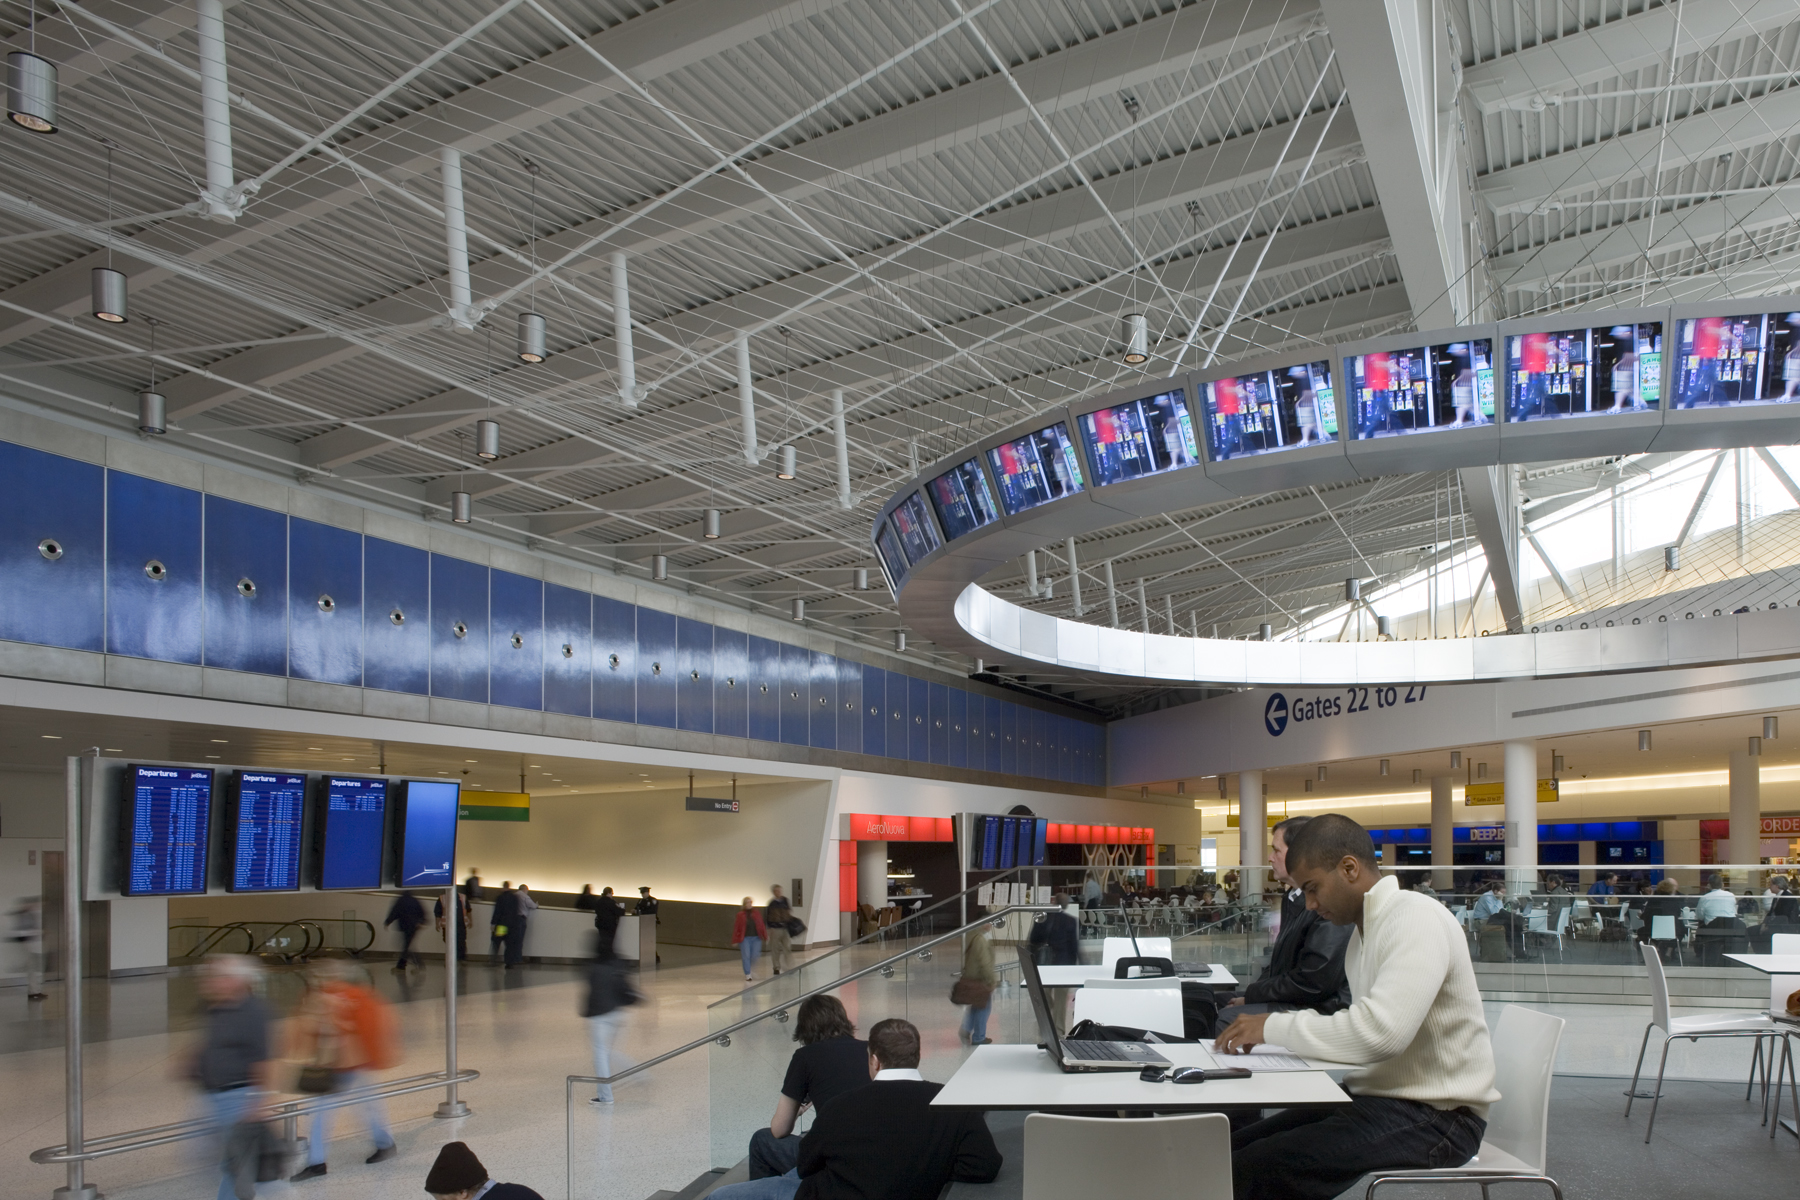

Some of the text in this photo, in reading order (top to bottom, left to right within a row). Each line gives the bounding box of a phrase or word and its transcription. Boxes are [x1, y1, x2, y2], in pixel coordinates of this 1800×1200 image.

[1292, 695, 1341, 722] Gates
[1347, 687, 1369, 713] 22
[1375, 686, 1398, 709] to
[138, 768, 178, 778] Departures
[243, 774, 277, 783] Departures
[331, 779, 361, 787] Departures
[721, 802, 732, 810] Entry
[866, 820, 905, 835] AeroNuova
